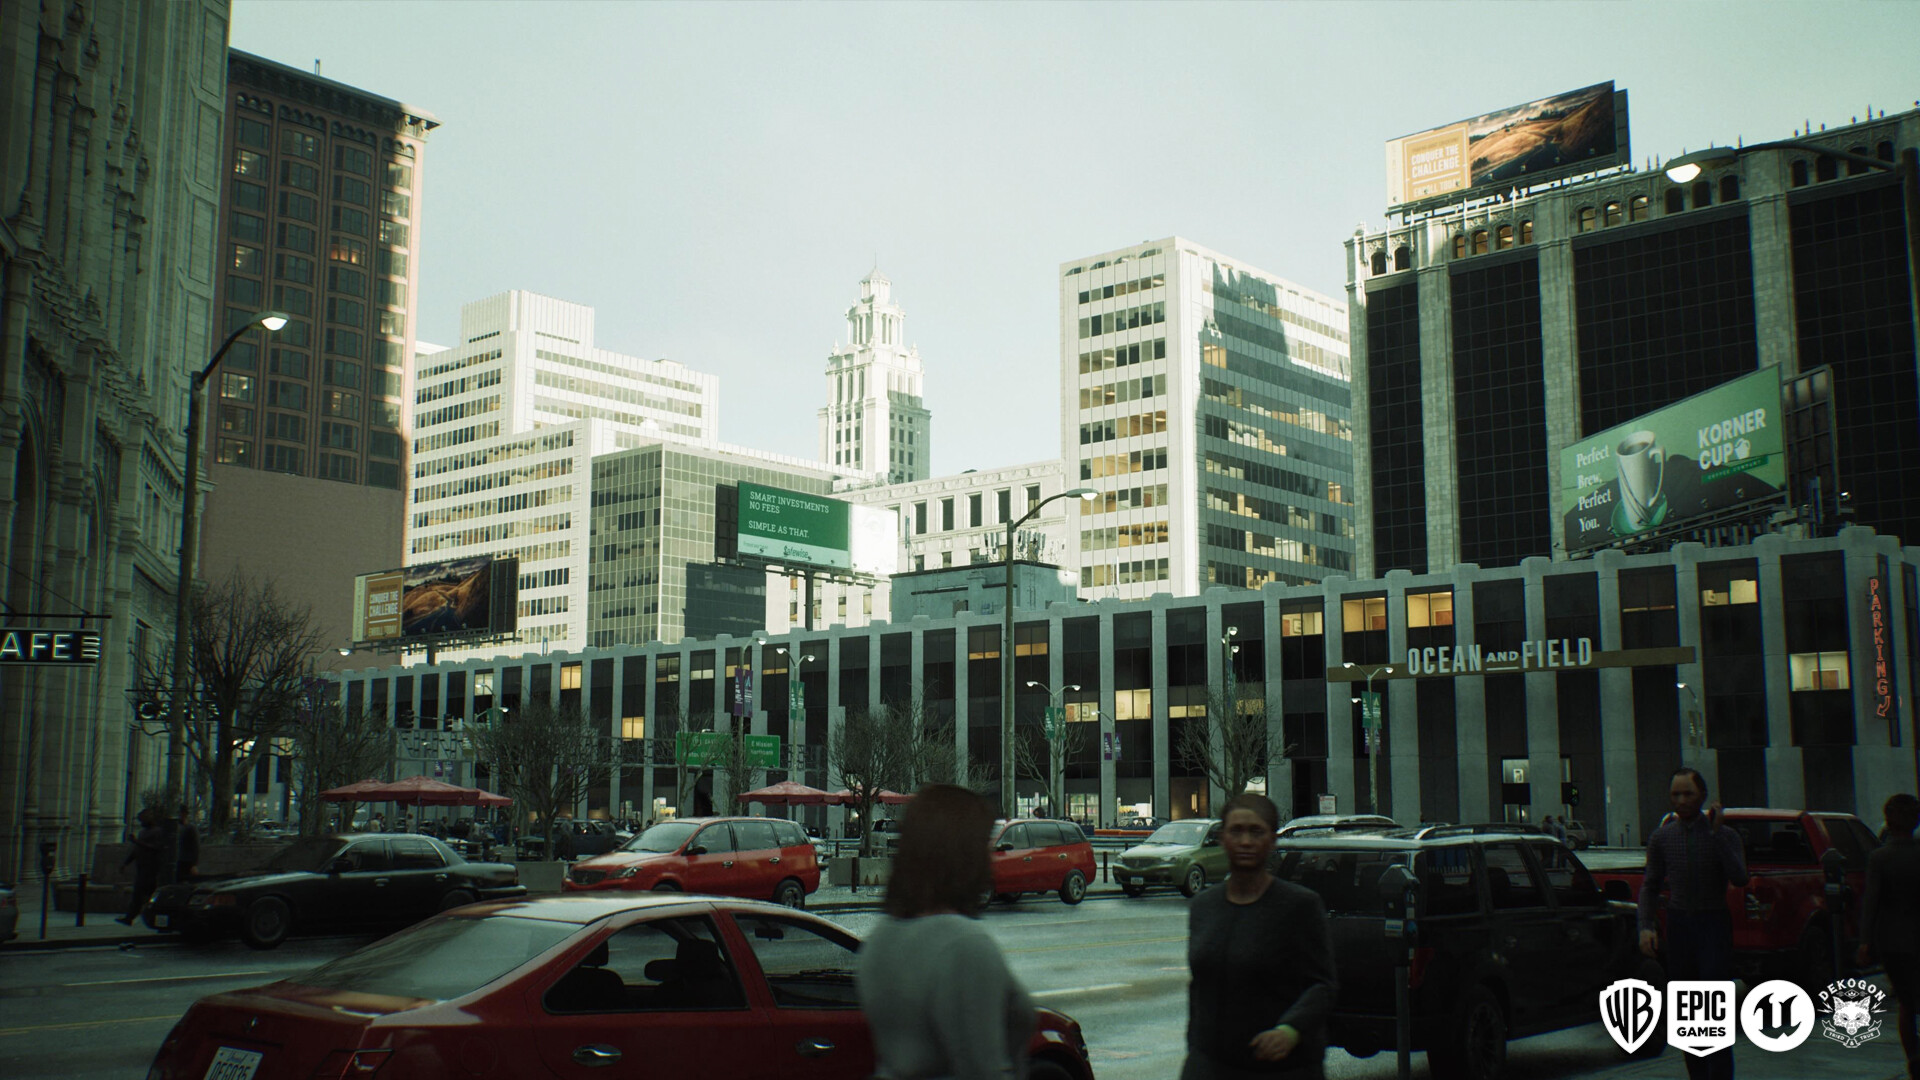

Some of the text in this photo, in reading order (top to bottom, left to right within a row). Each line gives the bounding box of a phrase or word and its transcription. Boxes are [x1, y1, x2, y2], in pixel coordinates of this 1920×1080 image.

[1411, 148, 1443, 165] CONQUER
[1445, 144, 1459, 156] THE
[1412, 155, 1460, 178] CHALLENGE
[1698, 408, 1766, 448] KORNER
[1576, 444, 1610, 468] Perfect
[1699, 442, 1733, 470] CUP
[749, 501, 780, 514] NO FEES
[750, 491, 829, 514] SMART INVESTMENTS
[1578, 488, 1612, 511] Perfect
[748, 520, 809, 538] SIMPLE AS THAT.
[1578, 517, 1600, 532] You.
[369, 602, 398, 617] CHALLENGE
[1869, 578, 1888, 696] PARKING
[1407, 637, 1592, 675] OCEAN AND FIELD
